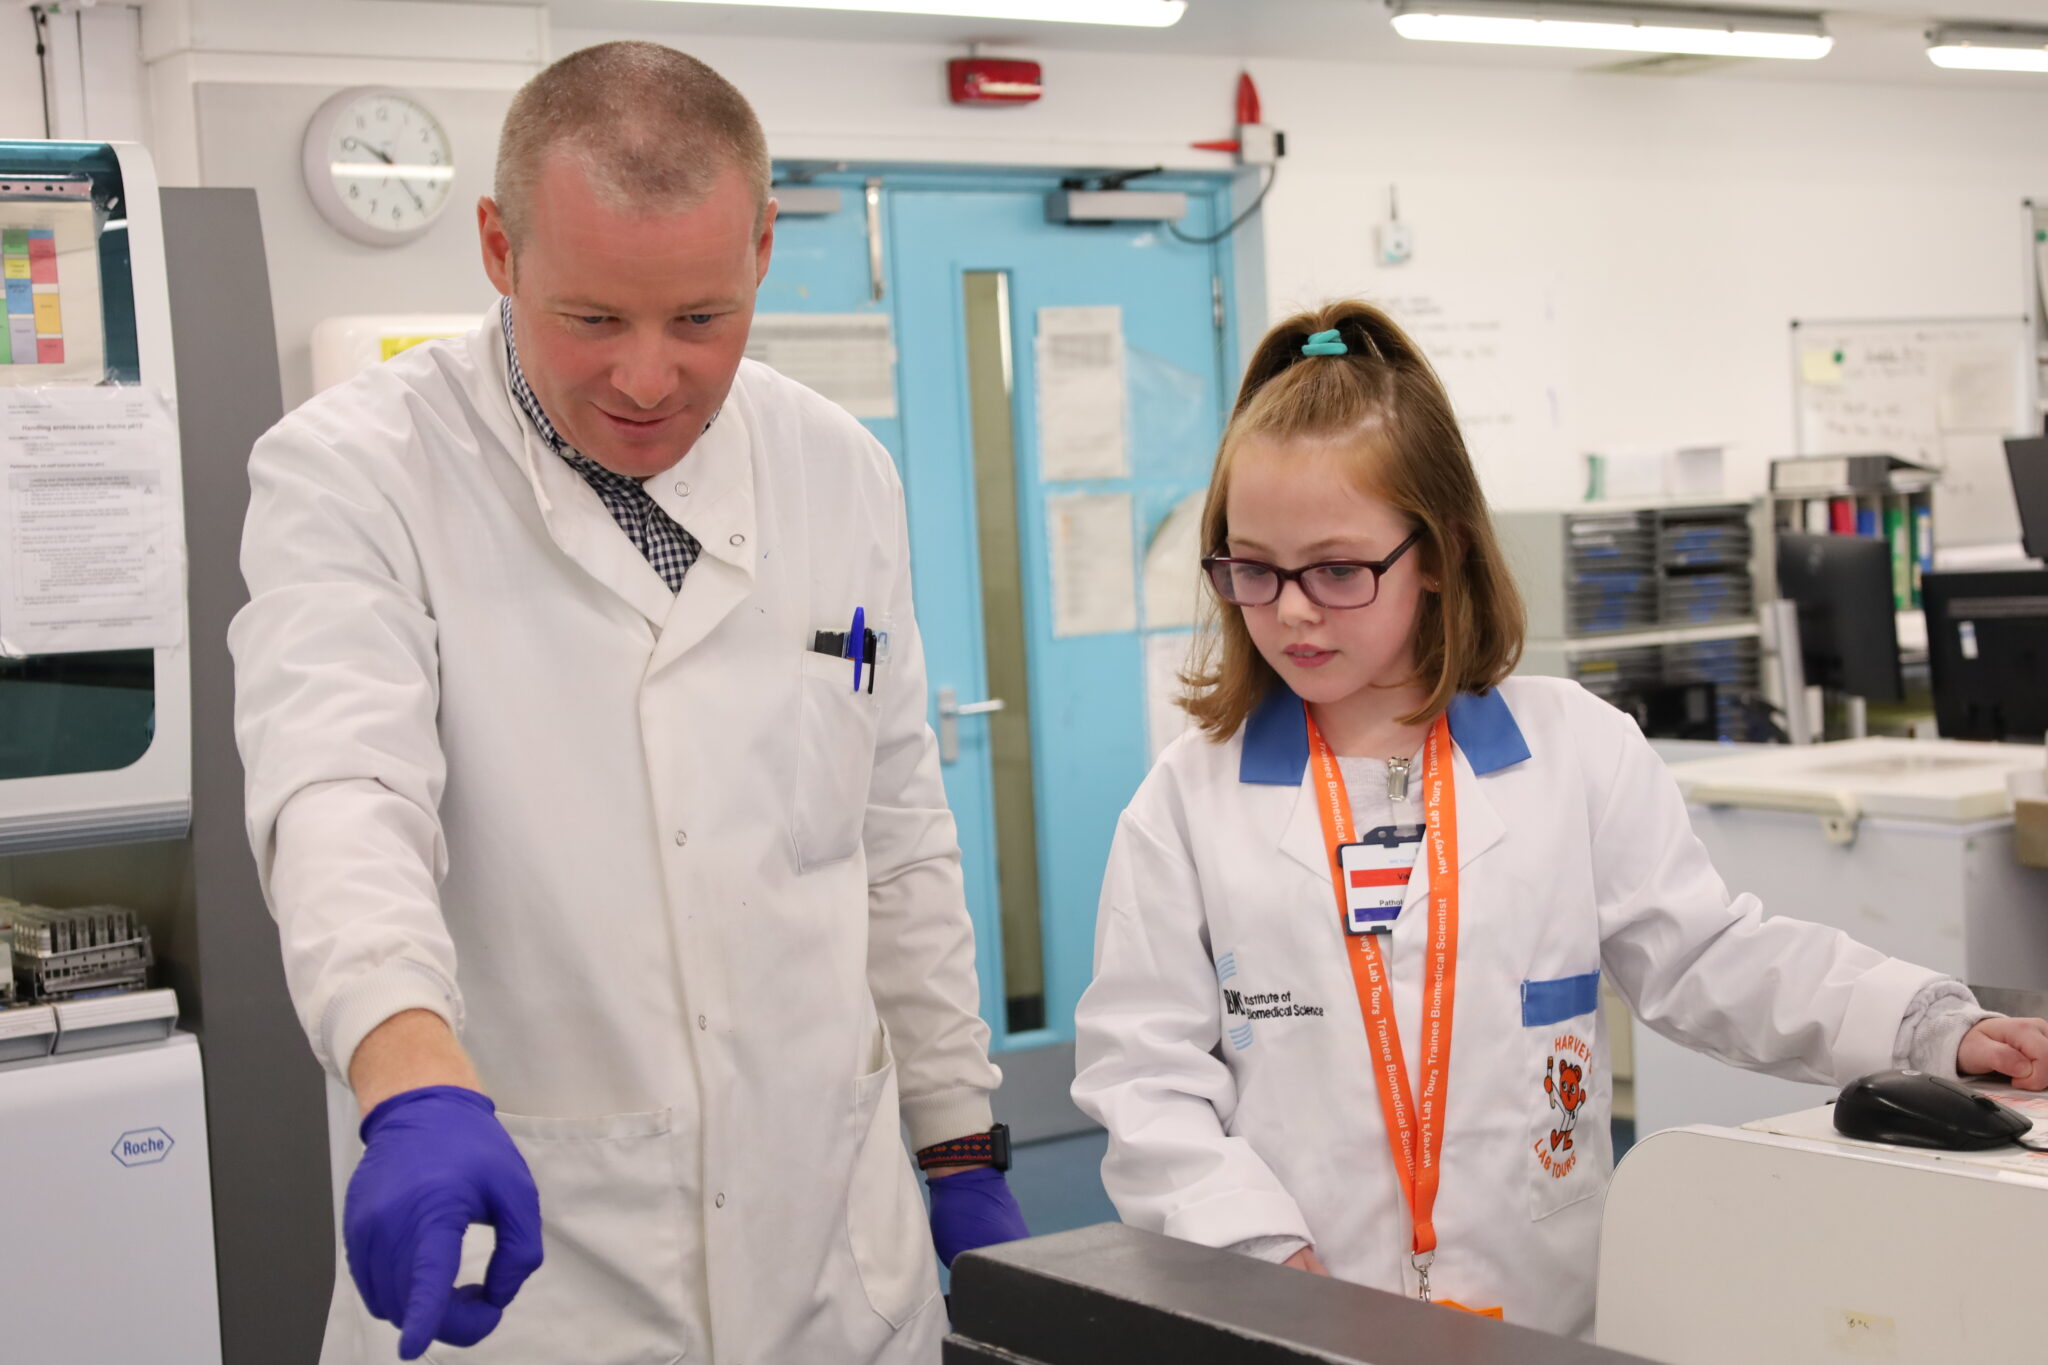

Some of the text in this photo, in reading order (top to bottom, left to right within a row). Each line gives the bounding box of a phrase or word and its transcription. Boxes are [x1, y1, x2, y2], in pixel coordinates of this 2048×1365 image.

[1428, 738, 1440, 778] Trainee
[1429, 780, 1442, 807] Tours
[1328, 781, 1348, 842] Biomedical
[1430, 810, 1440, 829] Lab
[1432, 831, 1448, 874] Harvey's
[1379, 898, 1403, 906] Pathol
[1360, 935, 1375, 961] vey's
[1367, 962, 1379, 983] Lab
[1244, 994, 1279, 1005] nstitute
[1293, 1004, 1324, 1017] Science
[1371, 985, 1383, 1016] Tours
[1377, 1018, 1392, 1062] Trainee
[1422, 897, 1447, 1168] Harvey's Lab Tours Trainee Biomedical Scientist
[1386, 1064, 1408, 1128] Biomedical
[123, 1137, 164, 1156] Roche
[1534, 1138, 1576, 1178] LAB TOURS
